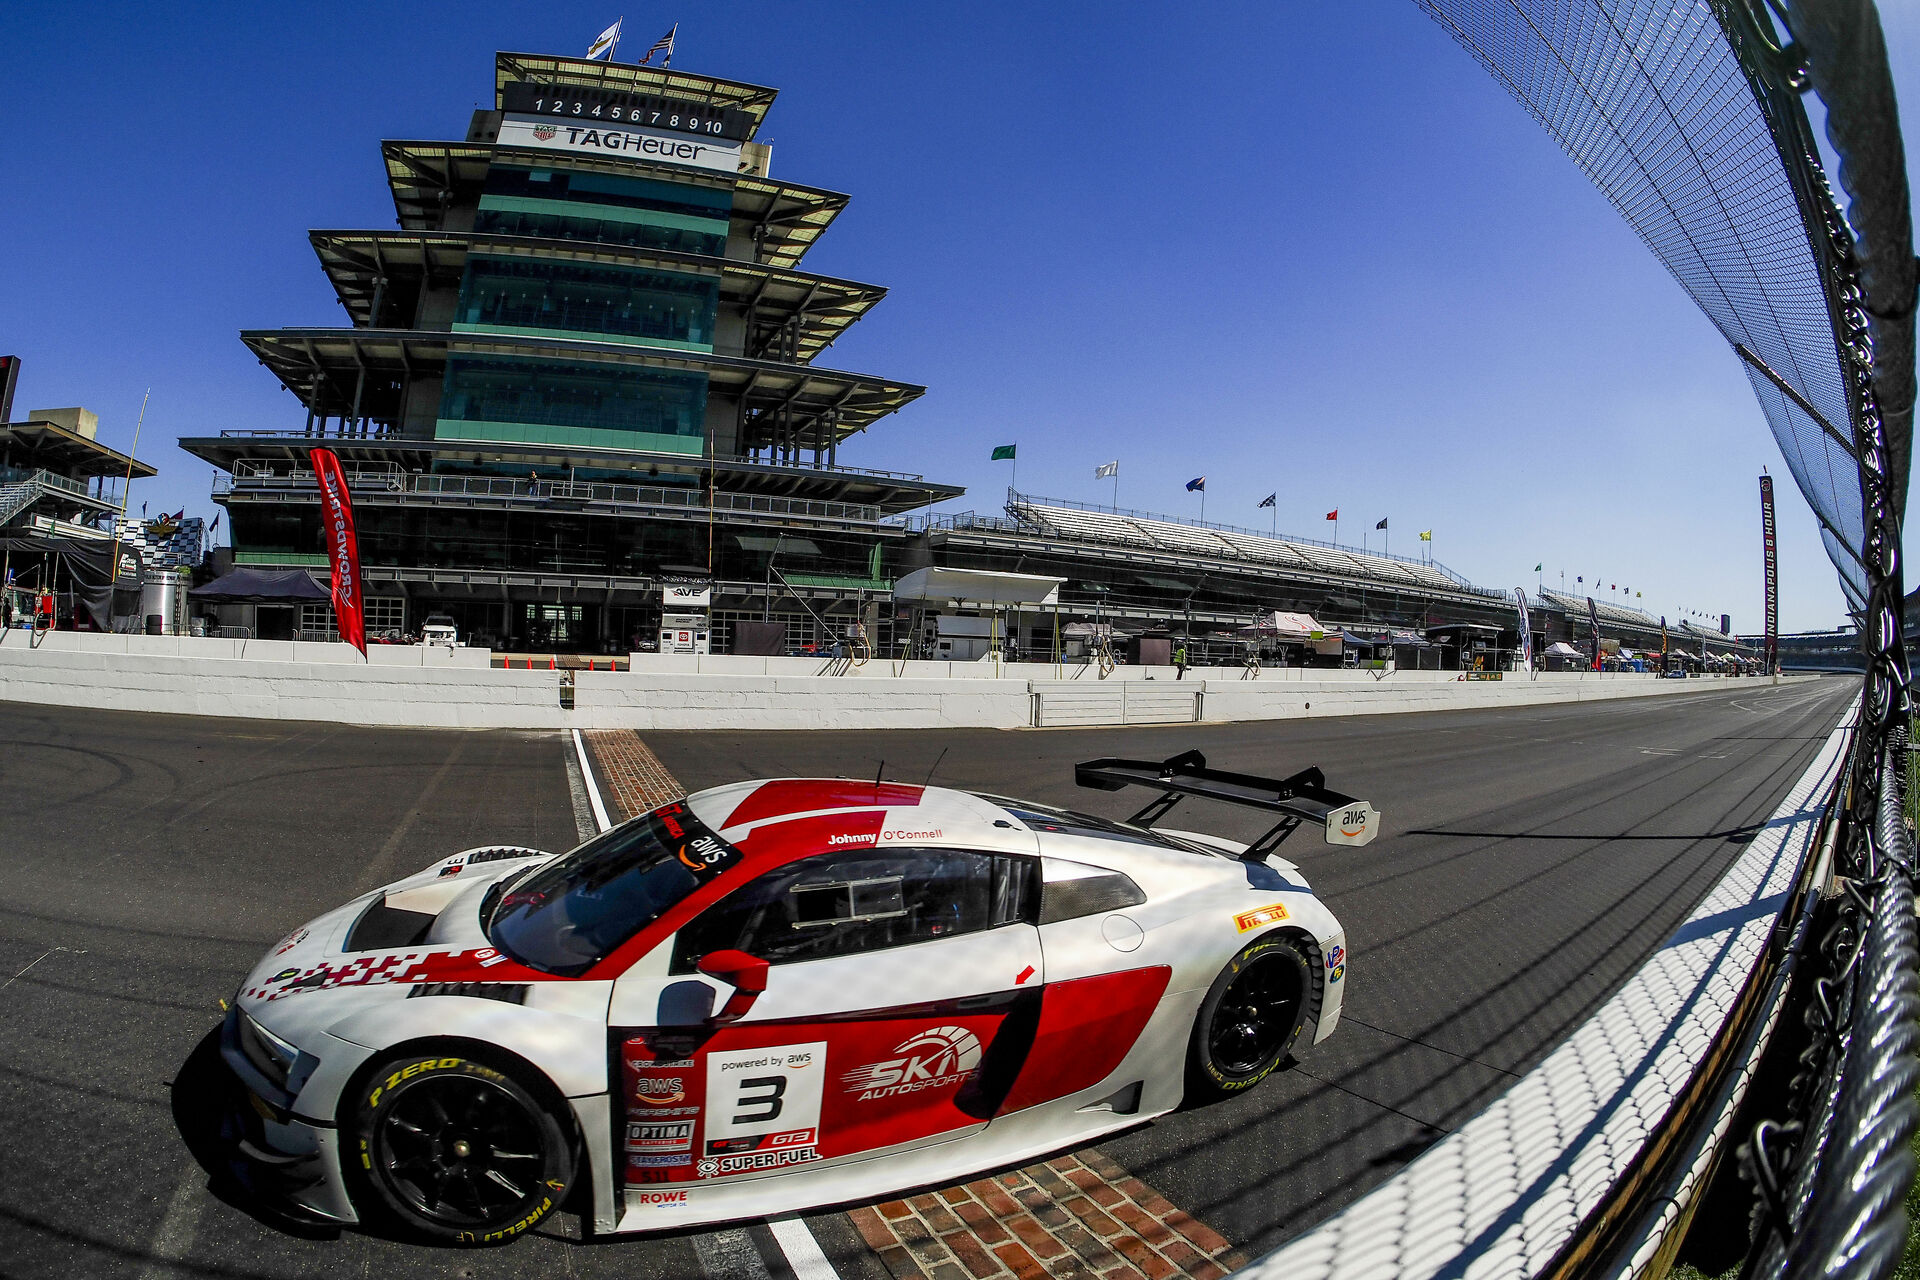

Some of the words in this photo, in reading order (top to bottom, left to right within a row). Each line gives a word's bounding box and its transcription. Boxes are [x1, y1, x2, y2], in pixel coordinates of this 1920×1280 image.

[535, 99, 543, 111] 1
[552, 101, 563, 113] 2
[572, 102, 582, 114] 3
[591, 104, 601, 117] 4
[611, 107, 621, 119] 5
[630, 109, 640, 121] 6
[650, 111, 661, 124] 7
[669, 114, 680, 127] 8
[689, 117, 699, 130] 9
[705, 119, 722, 134] 10
[1764, 502, 1773, 535] HOUR
[1766, 538, 1774, 547] 8
[1766, 550, 1775, 637] INDIANAPOLIS
[654, 804, 683, 817] GT
[1343, 809, 1366, 825] aws
[691, 835, 728, 864] aws
[827, 833, 877, 846] Johnny
[883, 829, 943, 840] O'Connell
[1236, 905, 1286, 931] PIRLLI
[721, 1056, 768, 1072] powered
[771, 1056, 784, 1067] by
[787, 1052, 811, 1064] aws
[862, 1050, 954, 1090] SKI
[369, 1086, 383, 1108] P
[385, 1057, 461, 1091] ZERO
[637, 1077, 683, 1094] aws
[857, 1070, 979, 1102] AUTOSPORTS
[731, 1075, 788, 1125] 3
[631, 1125, 688, 1138] OPTIMA
[771, 1131, 811, 1145] GT3
[722, 1154, 776, 1171] SUPER
[779, 1148, 818, 1164] FUEL
[640, 1191, 688, 1204] ROWE
[484, 1197, 552, 1242] PIRELLI
